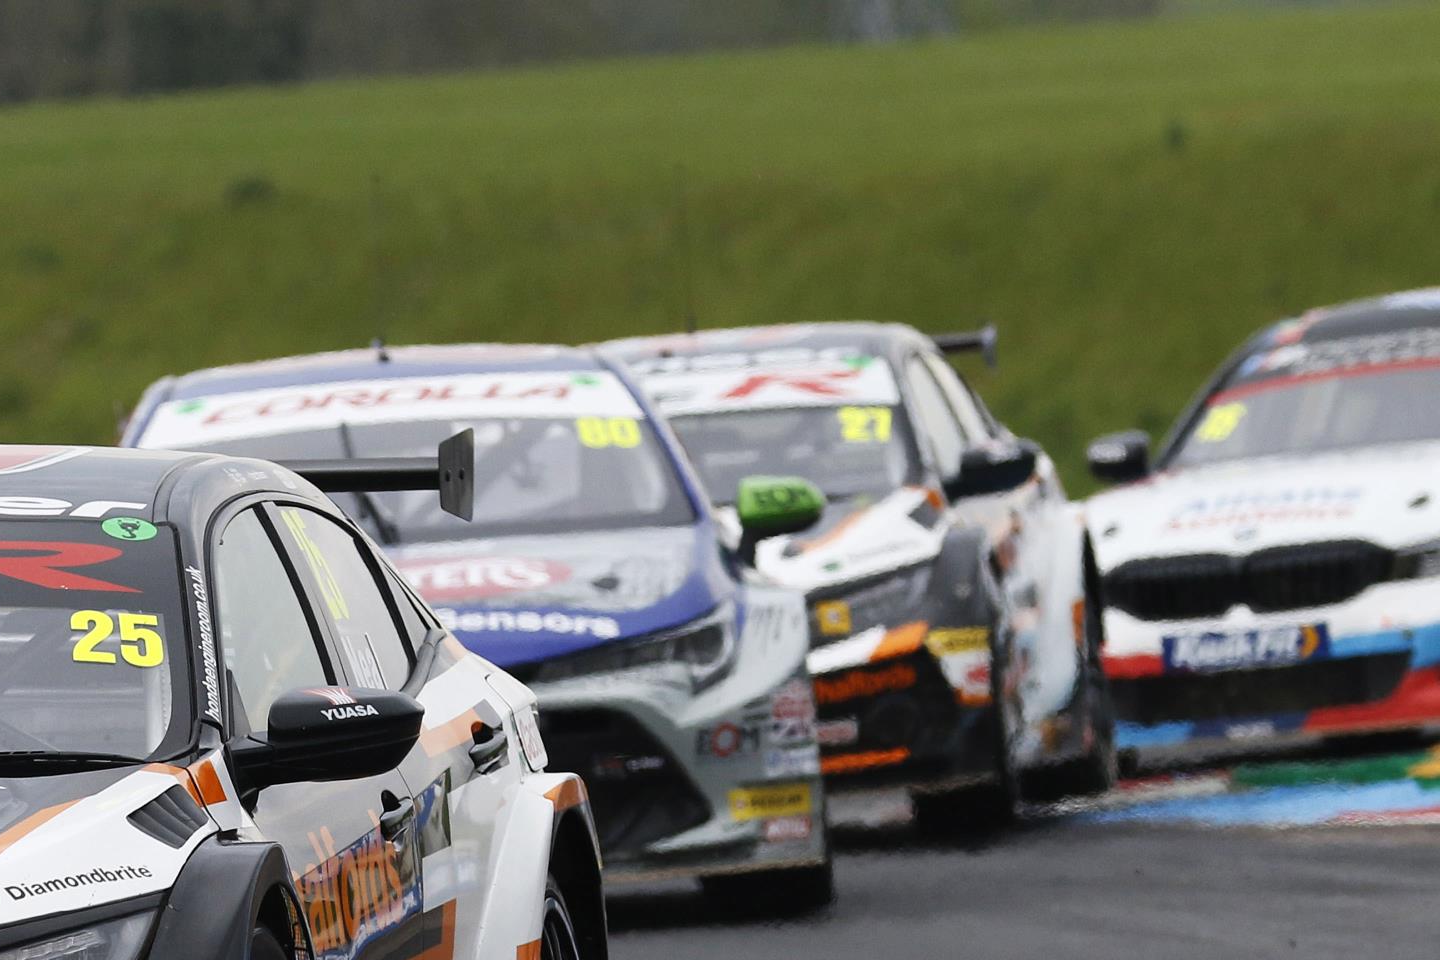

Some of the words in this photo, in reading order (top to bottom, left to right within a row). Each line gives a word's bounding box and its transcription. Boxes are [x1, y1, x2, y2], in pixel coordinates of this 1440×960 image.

[837, 405, 892, 442] 27
[70, 609, 164, 668] 25
[185, 566, 220, 722] hondaengineroom.co.uk
[320, 704, 379, 721] YUASA
[4, 865, 152, 900] Diamondbrite
